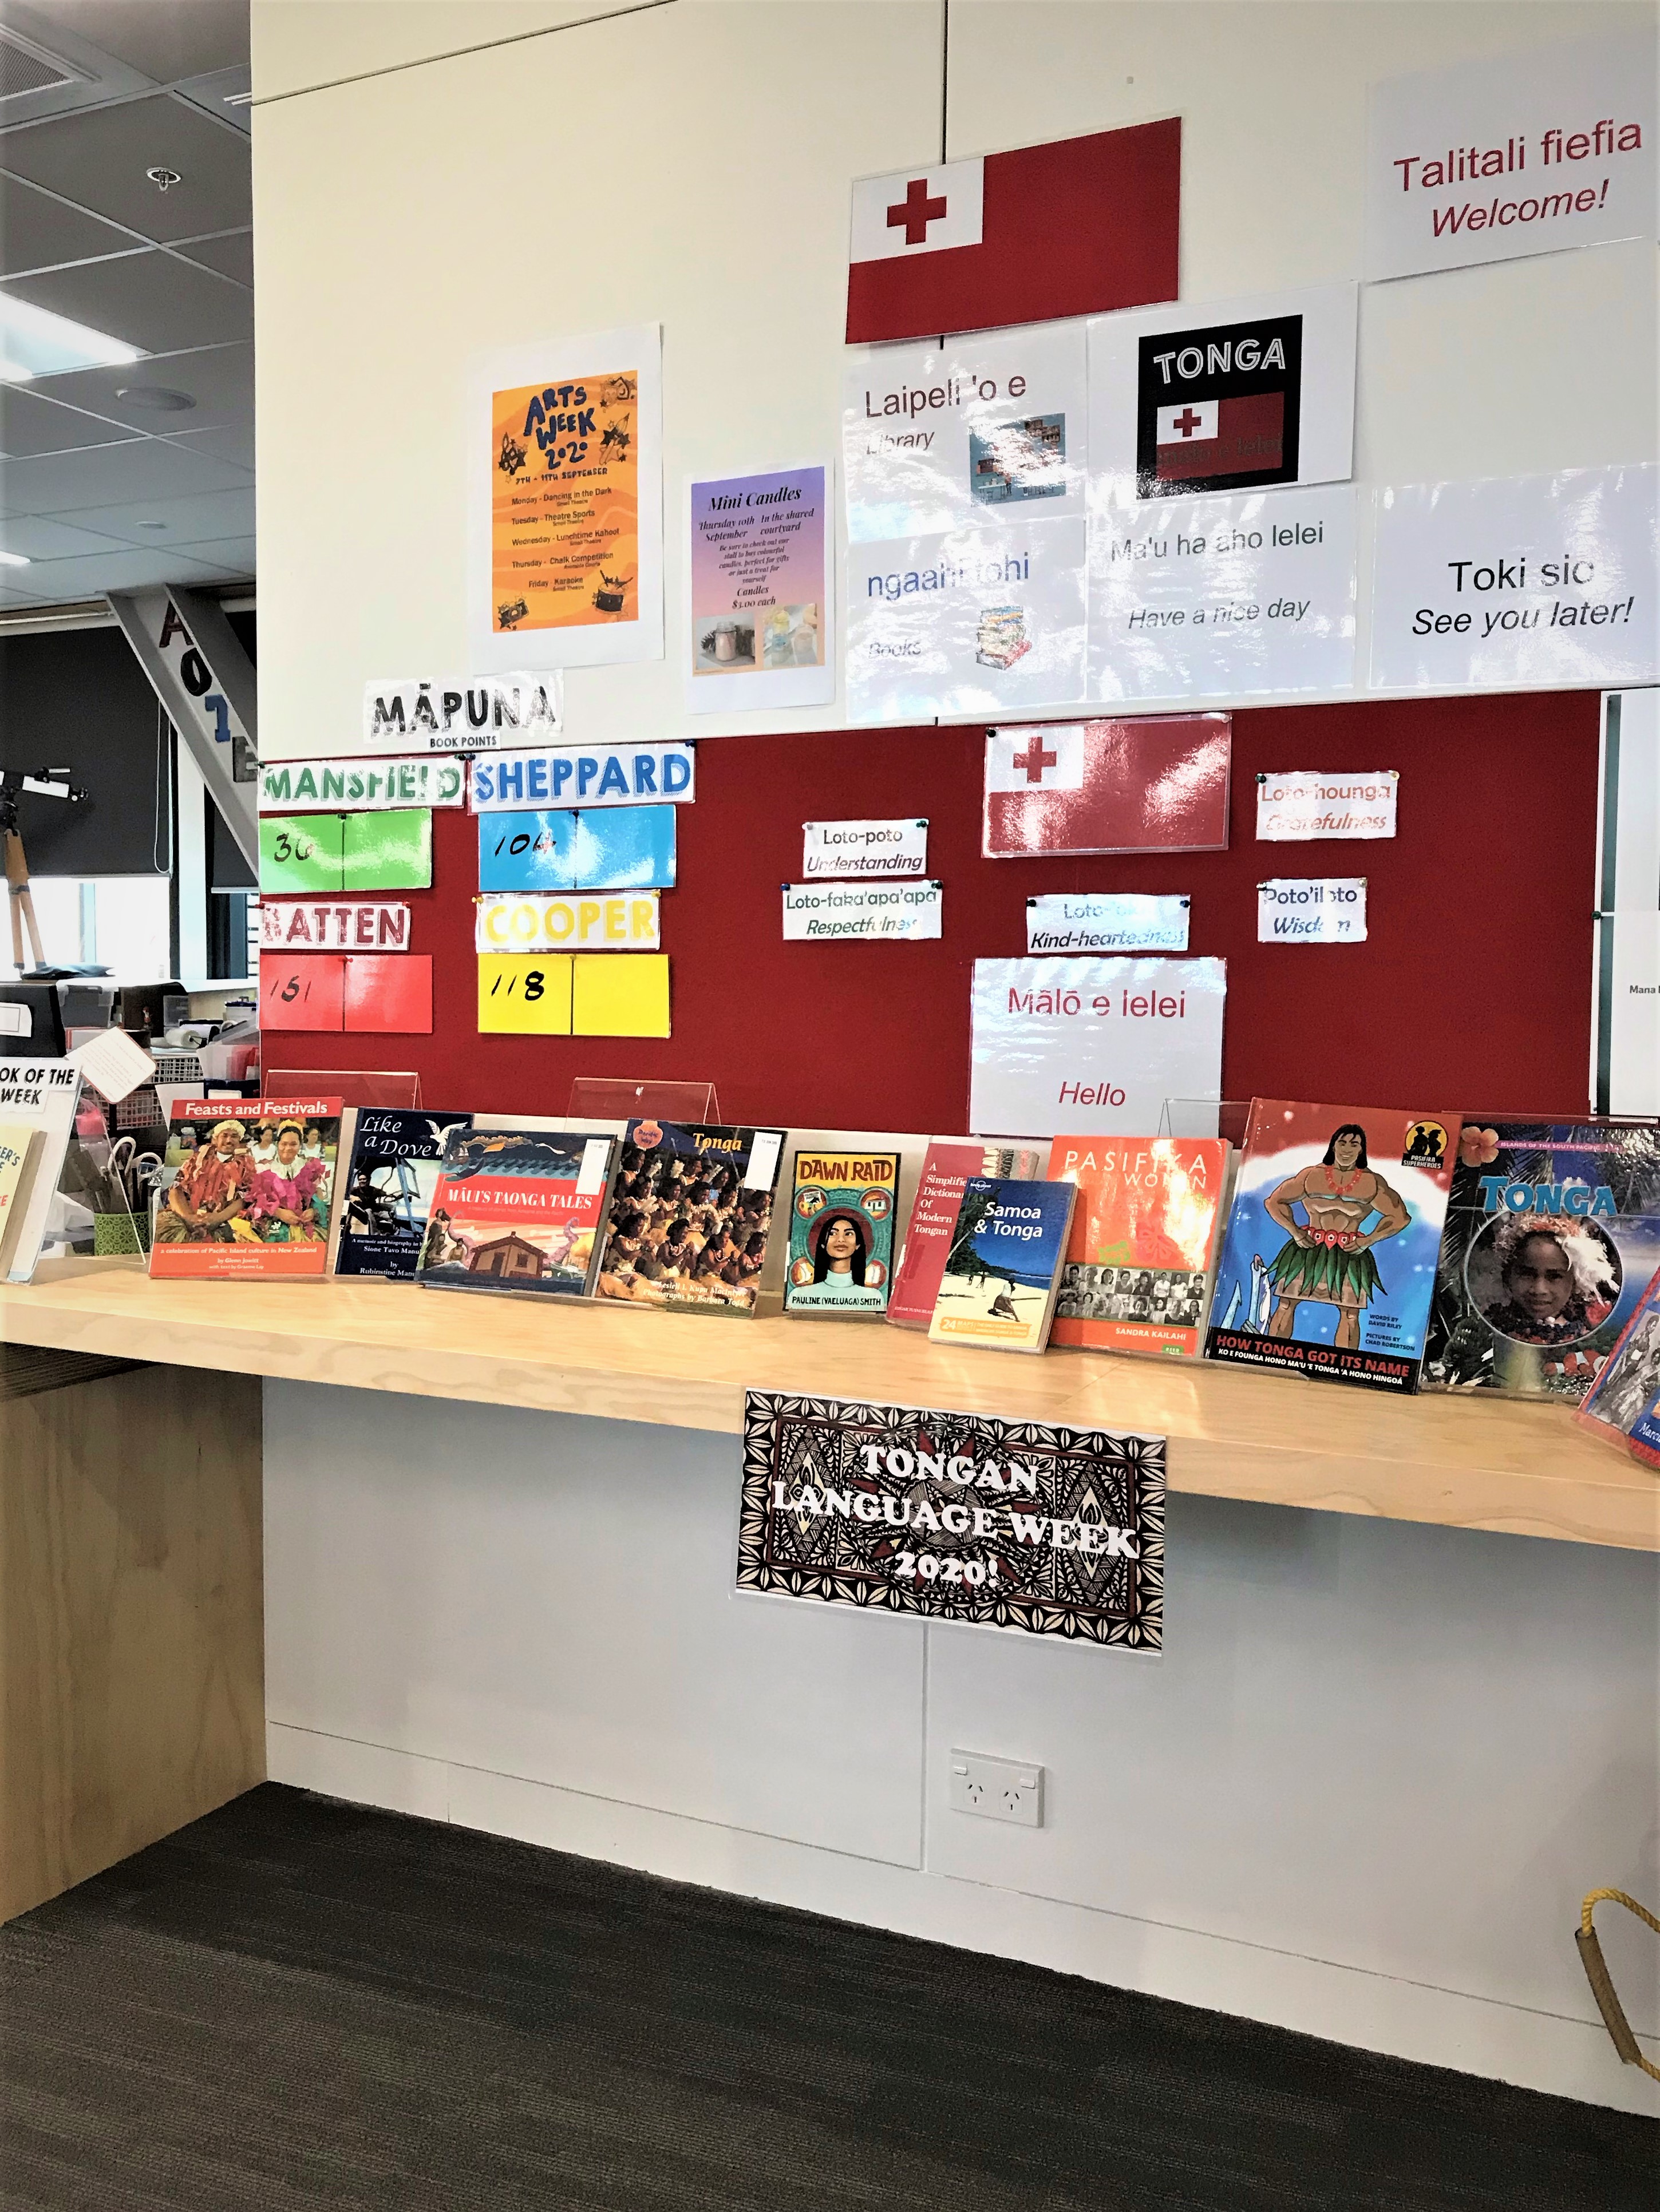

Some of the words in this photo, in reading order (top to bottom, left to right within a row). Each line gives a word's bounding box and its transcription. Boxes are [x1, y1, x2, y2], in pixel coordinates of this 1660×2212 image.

[1393, 136, 1525, 192] Talitali
[1540, 118, 1642, 165] fiefia
[1433, 179, 1610, 237] Welcome!
[1153, 338, 1286, 384] TONGA
[865, 378, 961, 419] Laipeli
[1008, 375, 1026, 397] e
[523, 385, 587, 437] ARTS
[536, 407, 596, 450] WEEK
[865, 430, 935, 454] Library
[544, 441, 588, 469] 2020
[515, 476, 531, 485] 7TH
[562, 467, 608, 480] SEPTEMBER
[512, 497, 537, 505] Monday
[543, 493, 572, 501] Dancing
[595, 486, 612, 496] Dark
[708, 493, 742, 511] Mini
[746, 486, 802, 506] Candles
[512, 517, 539, 525] Tuesday
[544, 512, 571, 521] Theatre
[572, 509, 595, 519] Sports
[699, 519, 736, 530] Thursday
[761, 515, 770, 523] In
[772, 513, 785, 521] the
[786, 508, 815, 520] shared
[512, 536, 551, 546] Wednesday
[556, 531, 593, 541] Lunchtime
[595, 528, 619, 537] Kahoot
[705, 529, 748, 542] September
[760, 521, 801, 535] courtyard
[1111, 538, 1168, 562] Ma'u
[1177, 533, 1207, 557] ha
[1272, 521, 1324, 548] lelei
[512, 560, 542, 568] Thursday
[550, 556, 569, 564] Chalk
[571, 552, 614, 563] Competition
[554, 577, 583, 585] Karaoke
[1448, 557, 1525, 592] Toki
[737, 585, 769, 596] Candles
[732, 600, 756, 610] $3.00
[757, 596, 776, 607] each
[1128, 608, 1185, 630] Have
[1192, 610, 1206, 624] a
[1213, 601, 1260, 623] nice
[1267, 597, 1311, 623] day
[1412, 608, 1472, 635] See
[1481, 608, 1541, 638] you
[1550, 596, 1635, 628] later!
[371, 683, 556, 737] MĀPUNA
[430, 737, 459, 748] BOOK
[461, 735, 497, 747] POINTS
[473, 754, 691, 802] SHEPPARD
[495, 832, 556, 857] 104
[824, 829, 903, 846] Loto-poto
[807, 853, 923, 872] Understanding
[485, 900, 655, 943] COOPER
[270, 975, 311, 1002] 151
[491, 971, 545, 1001] 118
[1630, 985, 1656, 994] Mana
[1092, 995, 1110, 1016] e
[1123, 990, 1185, 1018] lelei
[24, 1069, 45, 1085] OF
[49, 1069, 75, 1086] THE
[1, 1088, 42, 1106] WEEK
[1058, 1082, 1126, 1107] Hello
[185, 1102, 232, 1115] Feasts
[235, 1103, 260, 1115] and
[264, 1101, 327, 1115] Festivals
[359, 1115, 402, 1134] Like
[364, 1136, 378, 1147] a
[380, 1139, 432, 1157] Dove
[693, 1133, 742, 1154] Tonga
[799, 1159, 849, 1181] DAWN
[851, 1159, 893, 1181] RAID
[929, 1162, 937, 1172] A
[1065, 1150, 1207, 1175] PASIFIKA
[1403, 1160, 1441, 1169] SUPERHEROES
[448, 1187, 492, 1204] MĀUI'S
[494, 1191, 546, 1208] TAONGA
[550, 1194, 593, 1209] TALES
[920, 1199, 934, 1208] Of
[1480, 1176, 1618, 1217] TONGA
[916, 1212, 952, 1224] Modern
[984, 1201, 1041, 1219] Samoa
[914, 1224, 948, 1236] Tongan
[974, 1218, 987, 1234] &
[993, 1220, 1043, 1241] Tonga
[643, 1289, 685, 1301] Photographs
[687, 1293, 695, 1301] by
[697, 1295, 725, 1304] Barbara
[792, 1296, 821, 1305] PAULINE
[822, 1296, 859, 1305] (VAELUAGA)
[860, 1297, 882, 1306] SMITH
[942, 1319, 957, 1330] 24
[1116, 1328, 1149, 1338] SANDRA
[1151, 1329, 1187, 1340] KAILAHI
[1366, 1333, 1392, 1341] PICTURES
[1382, 1342, 1415, 1351] ROBERTSON
[1216, 1335, 1254, 1351] HOW
[1255, 1340, 1304, 1360] TONGA
[1307, 1350, 1338, 1364] GOT
[1341, 1355, 1362, 1370] ITS
[1365, 1359, 1410, 1377] NAME
[1235, 1351, 1264, 1362] FOUNGA
[1264, 1355, 1287, 1365] HONO
[1287, 1359, 1306, 1368] MA'U
[1315, 1364, 1340, 1374] TONGA
[1349, 1370, 1372, 1380] HONO
[1373, 1374, 1403, 1385] HINGOÁ
[860, 1443, 1038, 1497] TONGAN
[772, 1481, 998, 1540] LANGUAGE
[1009, 1511, 1140, 1560] WEEK
[894, 1551, 999, 1588] 2020!
